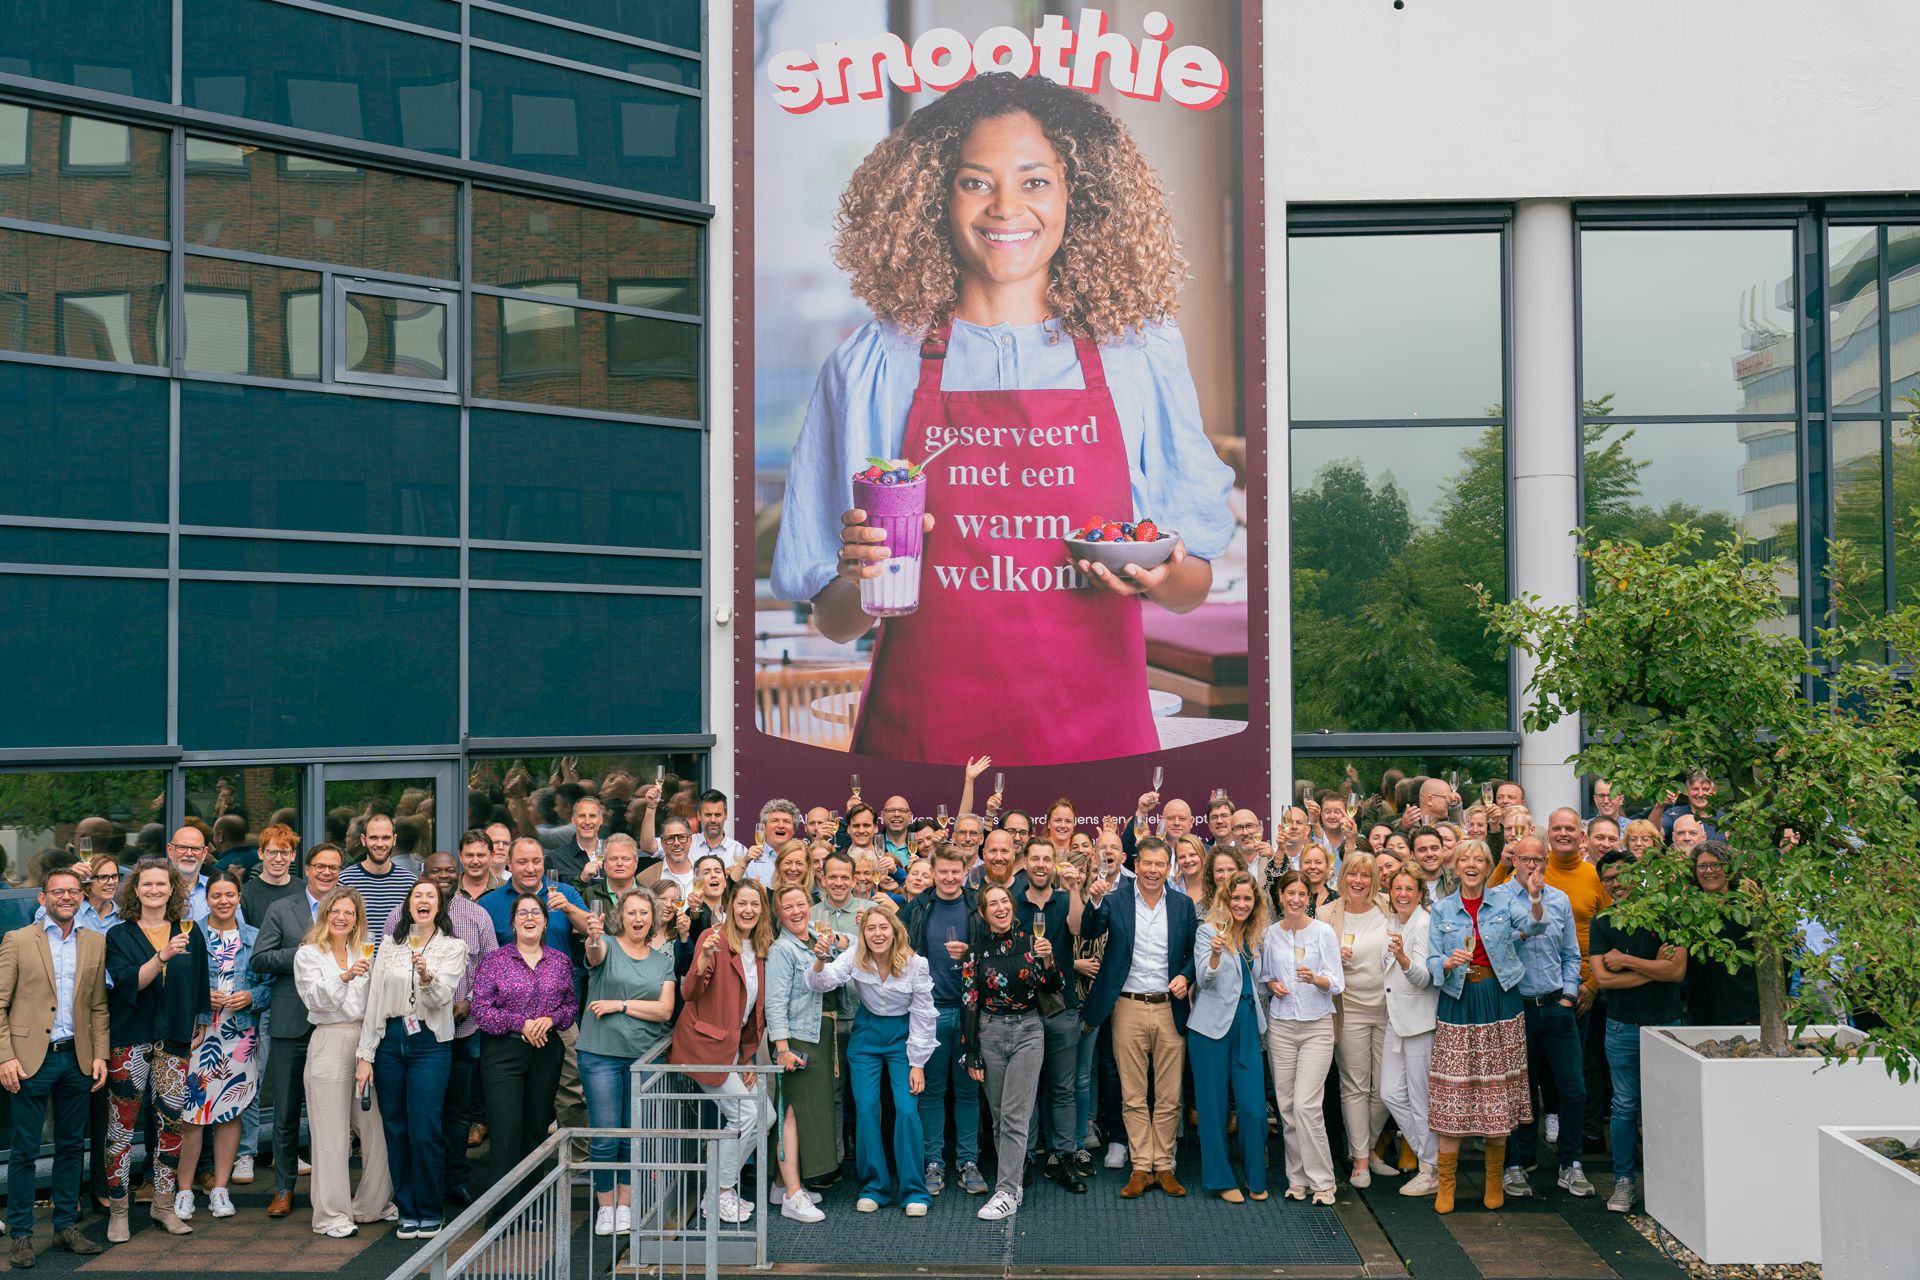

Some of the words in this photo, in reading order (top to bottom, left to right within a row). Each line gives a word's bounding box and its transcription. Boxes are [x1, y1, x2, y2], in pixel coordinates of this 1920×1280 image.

[767, 7, 1230, 115] smoothie
[924, 416, 1100, 453] geserveerd
[948, 461, 1011, 488] met
[1020, 464, 1076, 488] een
[953, 514, 1071, 540] warm
